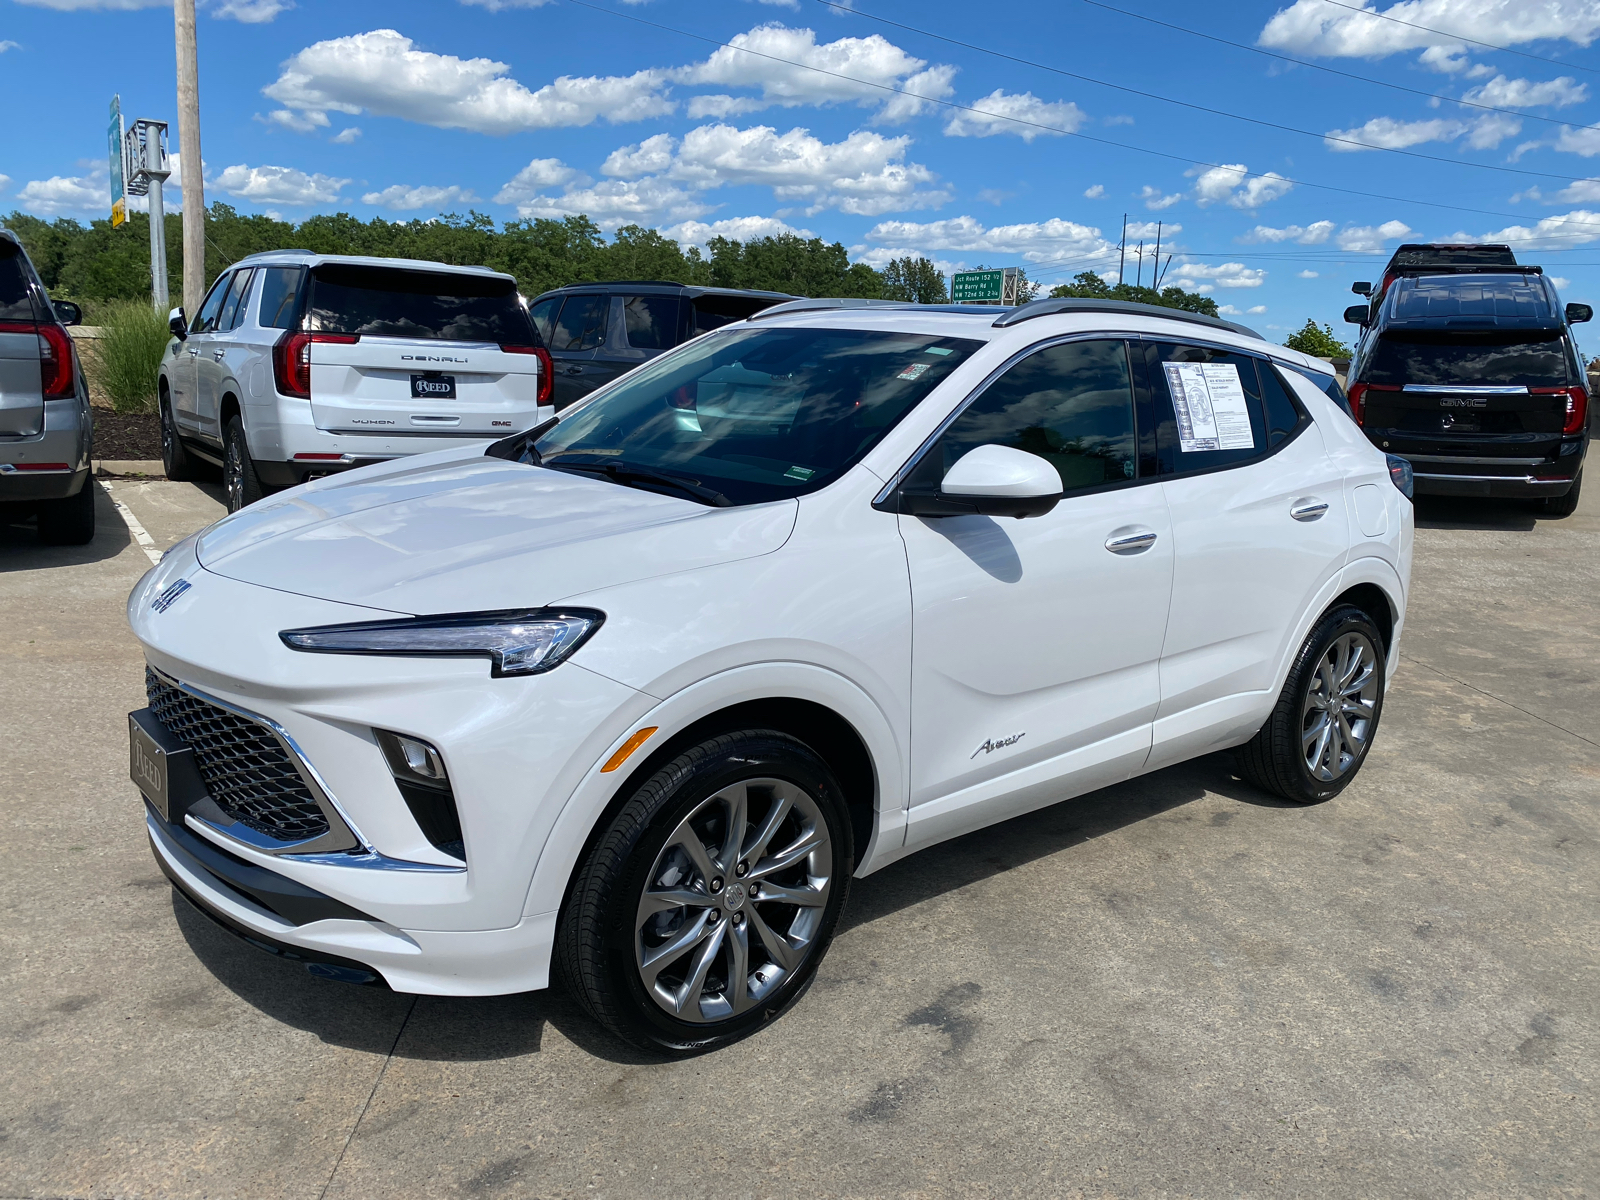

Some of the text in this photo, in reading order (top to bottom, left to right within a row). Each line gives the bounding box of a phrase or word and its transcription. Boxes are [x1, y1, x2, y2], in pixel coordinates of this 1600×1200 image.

[401, 354, 468, 364] DENALI
[416, 380, 450, 394] REED
[1440, 398, 1487, 408] GMC
[134, 739, 162, 792] REED
